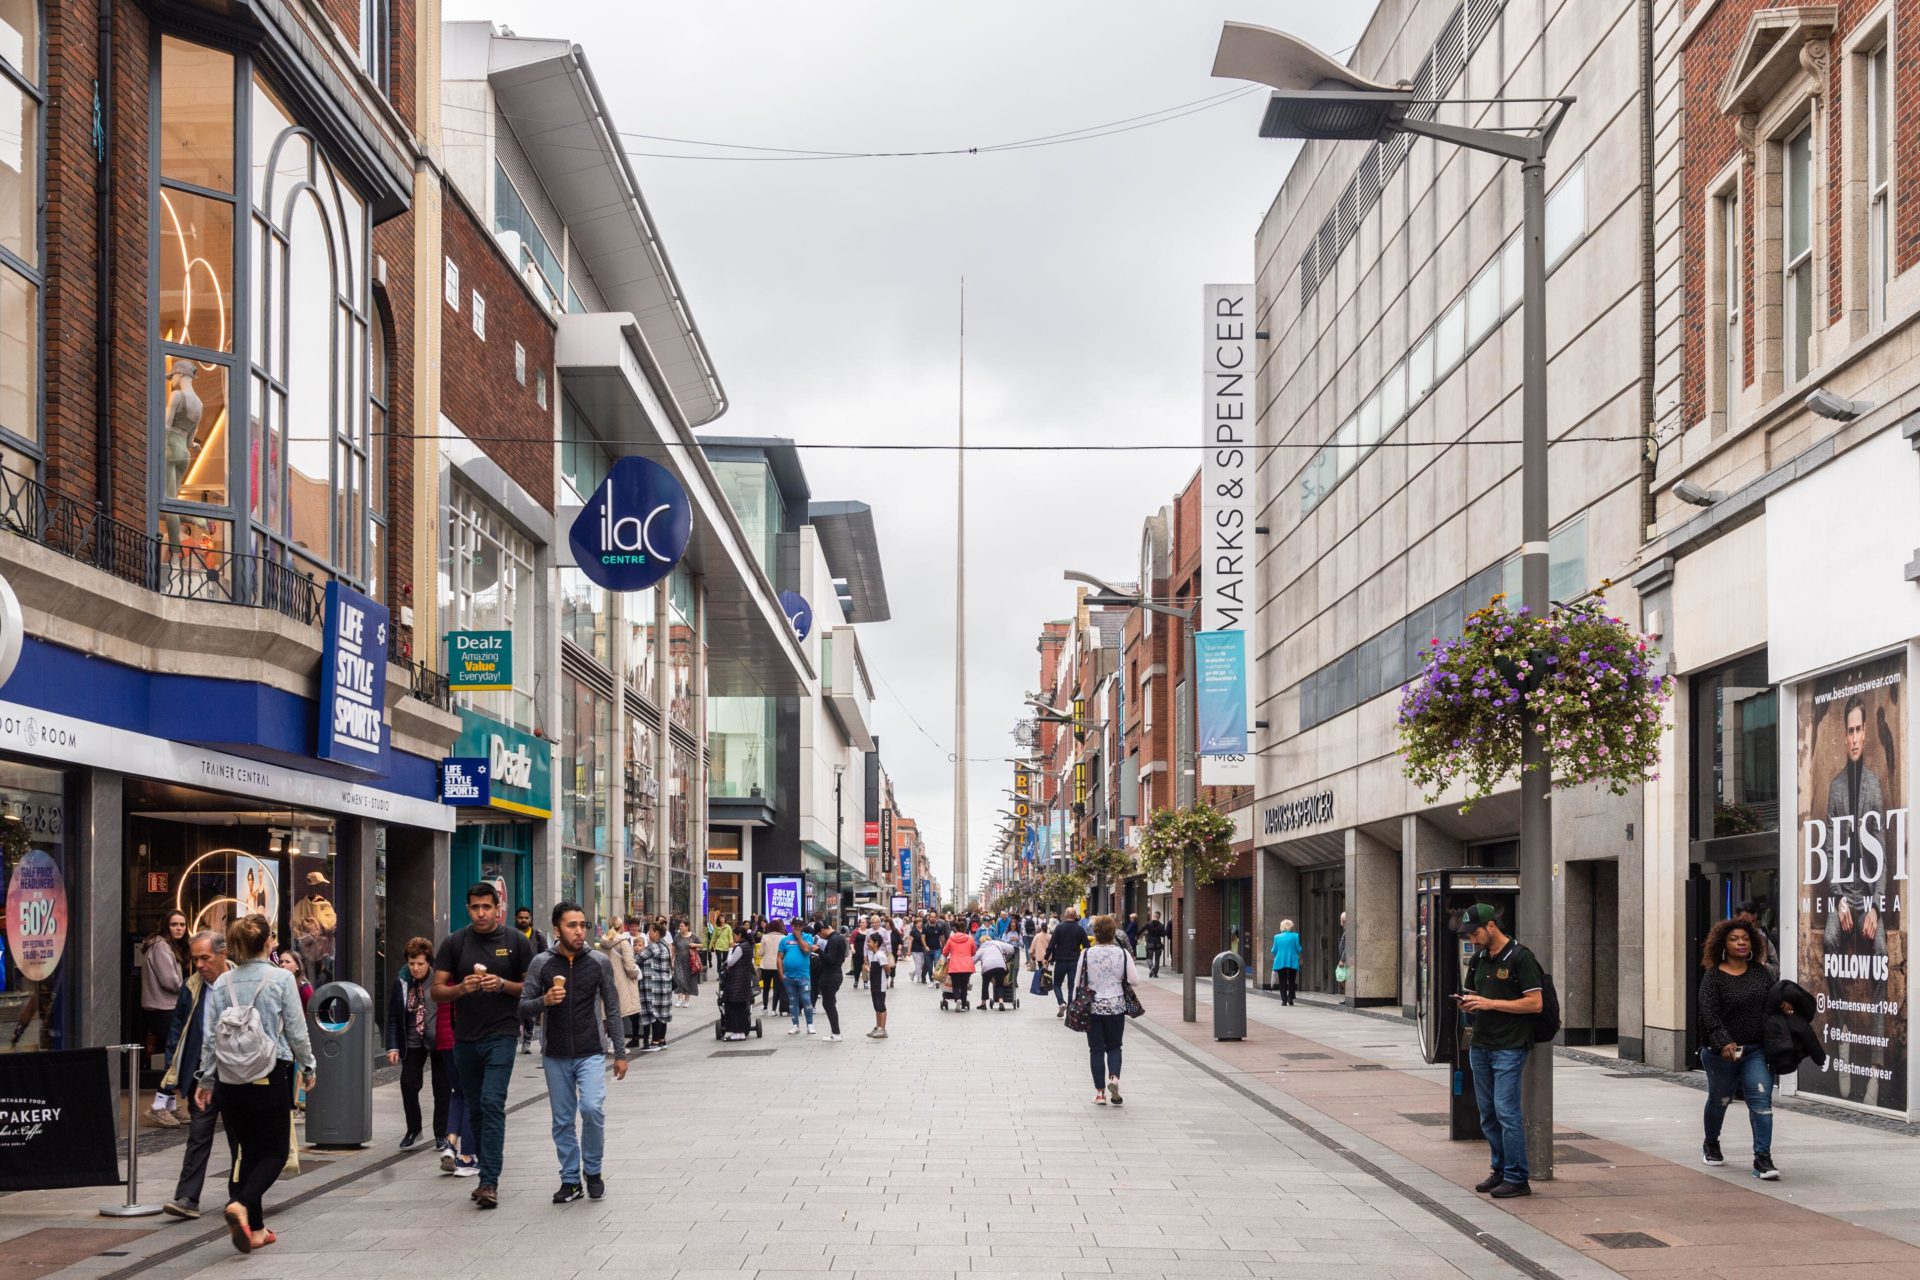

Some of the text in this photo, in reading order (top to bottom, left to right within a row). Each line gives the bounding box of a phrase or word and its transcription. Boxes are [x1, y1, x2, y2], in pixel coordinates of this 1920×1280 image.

[1216, 297, 1244, 469] SPENCER
[1216, 477, 1244, 499] &
[601, 478, 671, 562] ilac
[602, 555, 645, 564] CENTRE
[1216, 508, 1244, 631] MARKS
[339, 601, 364, 645] LIFE
[457, 635, 503, 649] Dealz
[461, 651, 499, 662] Amazing
[464, 661, 496, 672] Value
[337, 650, 374, 695] STYLE
[459, 671, 501, 682] Everyday!
[1814, 672, 1901, 705] www.bestmenswear.com
[335, 697, 380, 743] SPORTS
[0, 717, 77, 748] OT ROOM
[445, 764, 462, 774] LIFE
[491, 733, 532, 789] Dealz
[1213, 754, 1246, 762] M&S
[202, 760, 270, 787] TRAINER CENTRAL
[445, 775, 472, 785] STYLE
[445, 785, 480, 795] SPORTS
[1264, 789, 1334, 835] MARKS & SPENCER
[1802, 807, 1909, 885] BEST
[708, 861, 722, 870] RA
[773, 889, 795, 897] SOLVE
[1802, 894, 1901, 913] MENS WEA
[19, 898, 56, 936] 50%
[1824, 953, 1889, 981] FOLLOW US
[1827, 995, 1898, 1016] bestmenswear1948
[1830, 1026, 1890, 1047] @Bestmenswear
[1833, 1057, 1892, 1080] @Bestmenswear
